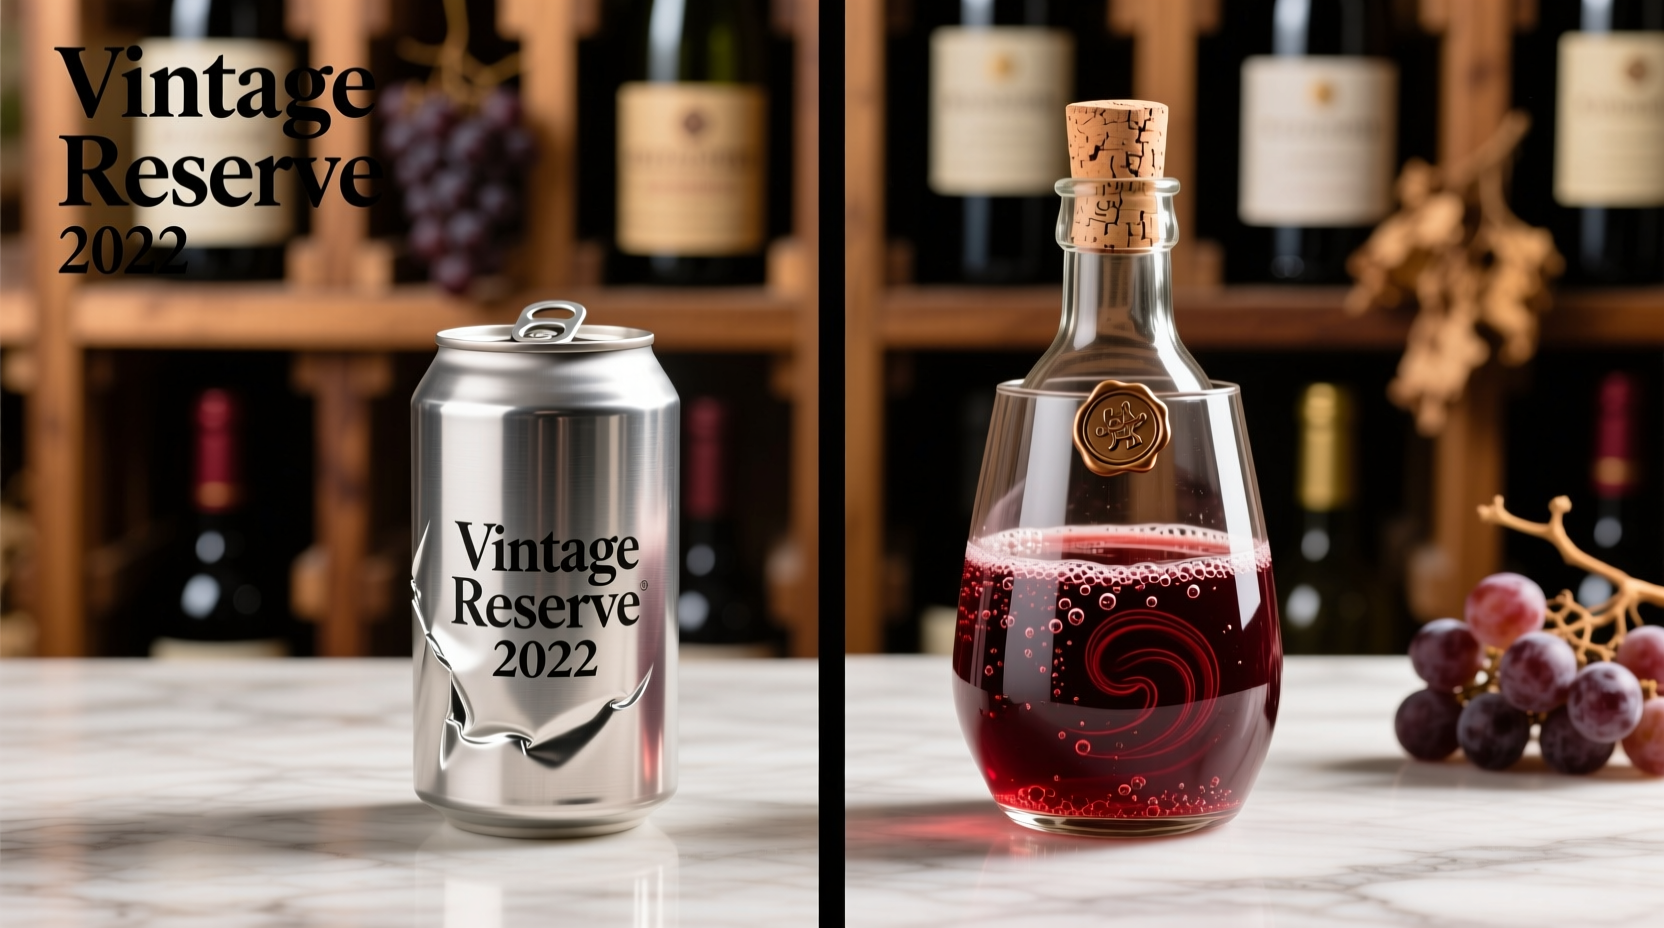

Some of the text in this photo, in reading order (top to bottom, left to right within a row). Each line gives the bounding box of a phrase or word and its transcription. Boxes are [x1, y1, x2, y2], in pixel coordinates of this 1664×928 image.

[455, 520, 640, 587] Vintage
[451, 576, 640, 630] Reserve
[492, 639, 598, 679] 2022
